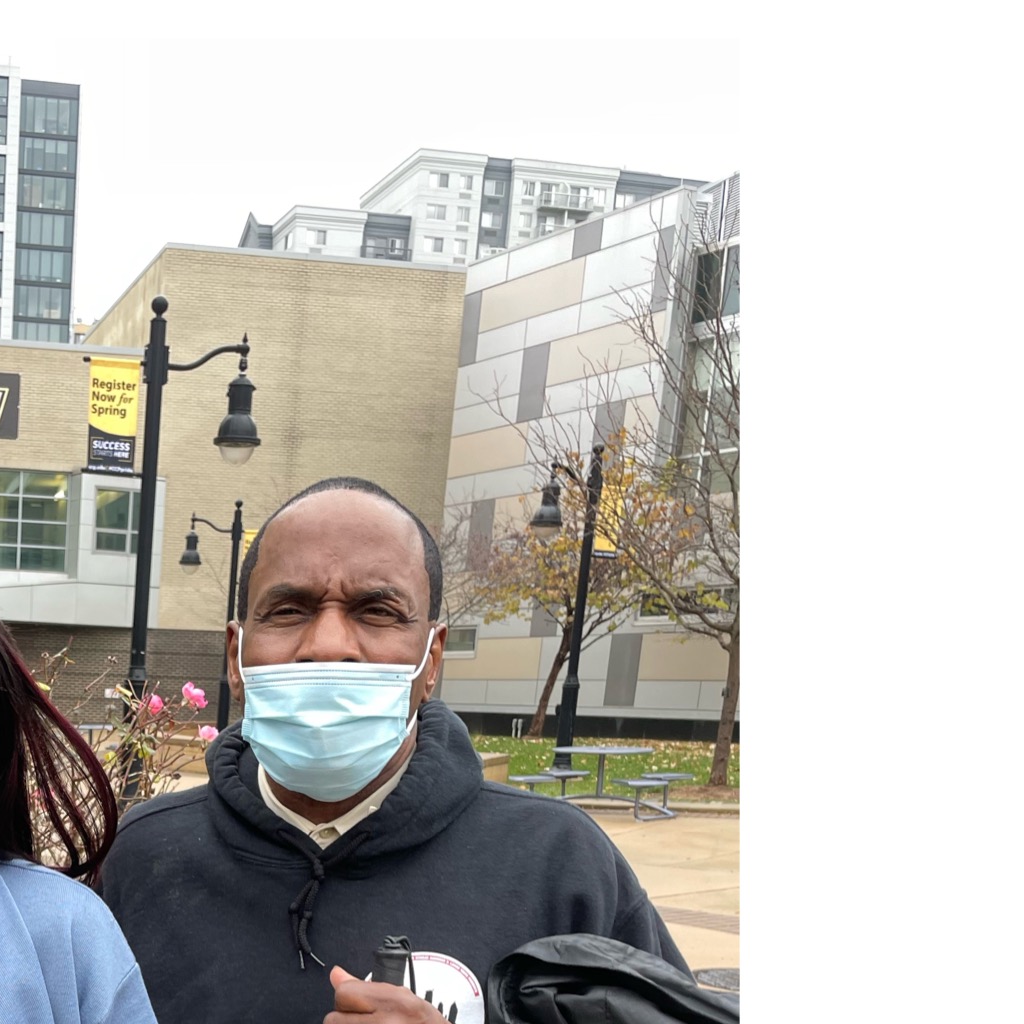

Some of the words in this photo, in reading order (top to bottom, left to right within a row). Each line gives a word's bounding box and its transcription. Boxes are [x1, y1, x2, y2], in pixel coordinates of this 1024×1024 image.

[92, 378, 136, 392] Register
[92, 391, 116, 402] Now
[117, 393, 134, 406] for
[91, 404, 127, 419] Spring
[92, 440, 130, 451] SUCCESS
